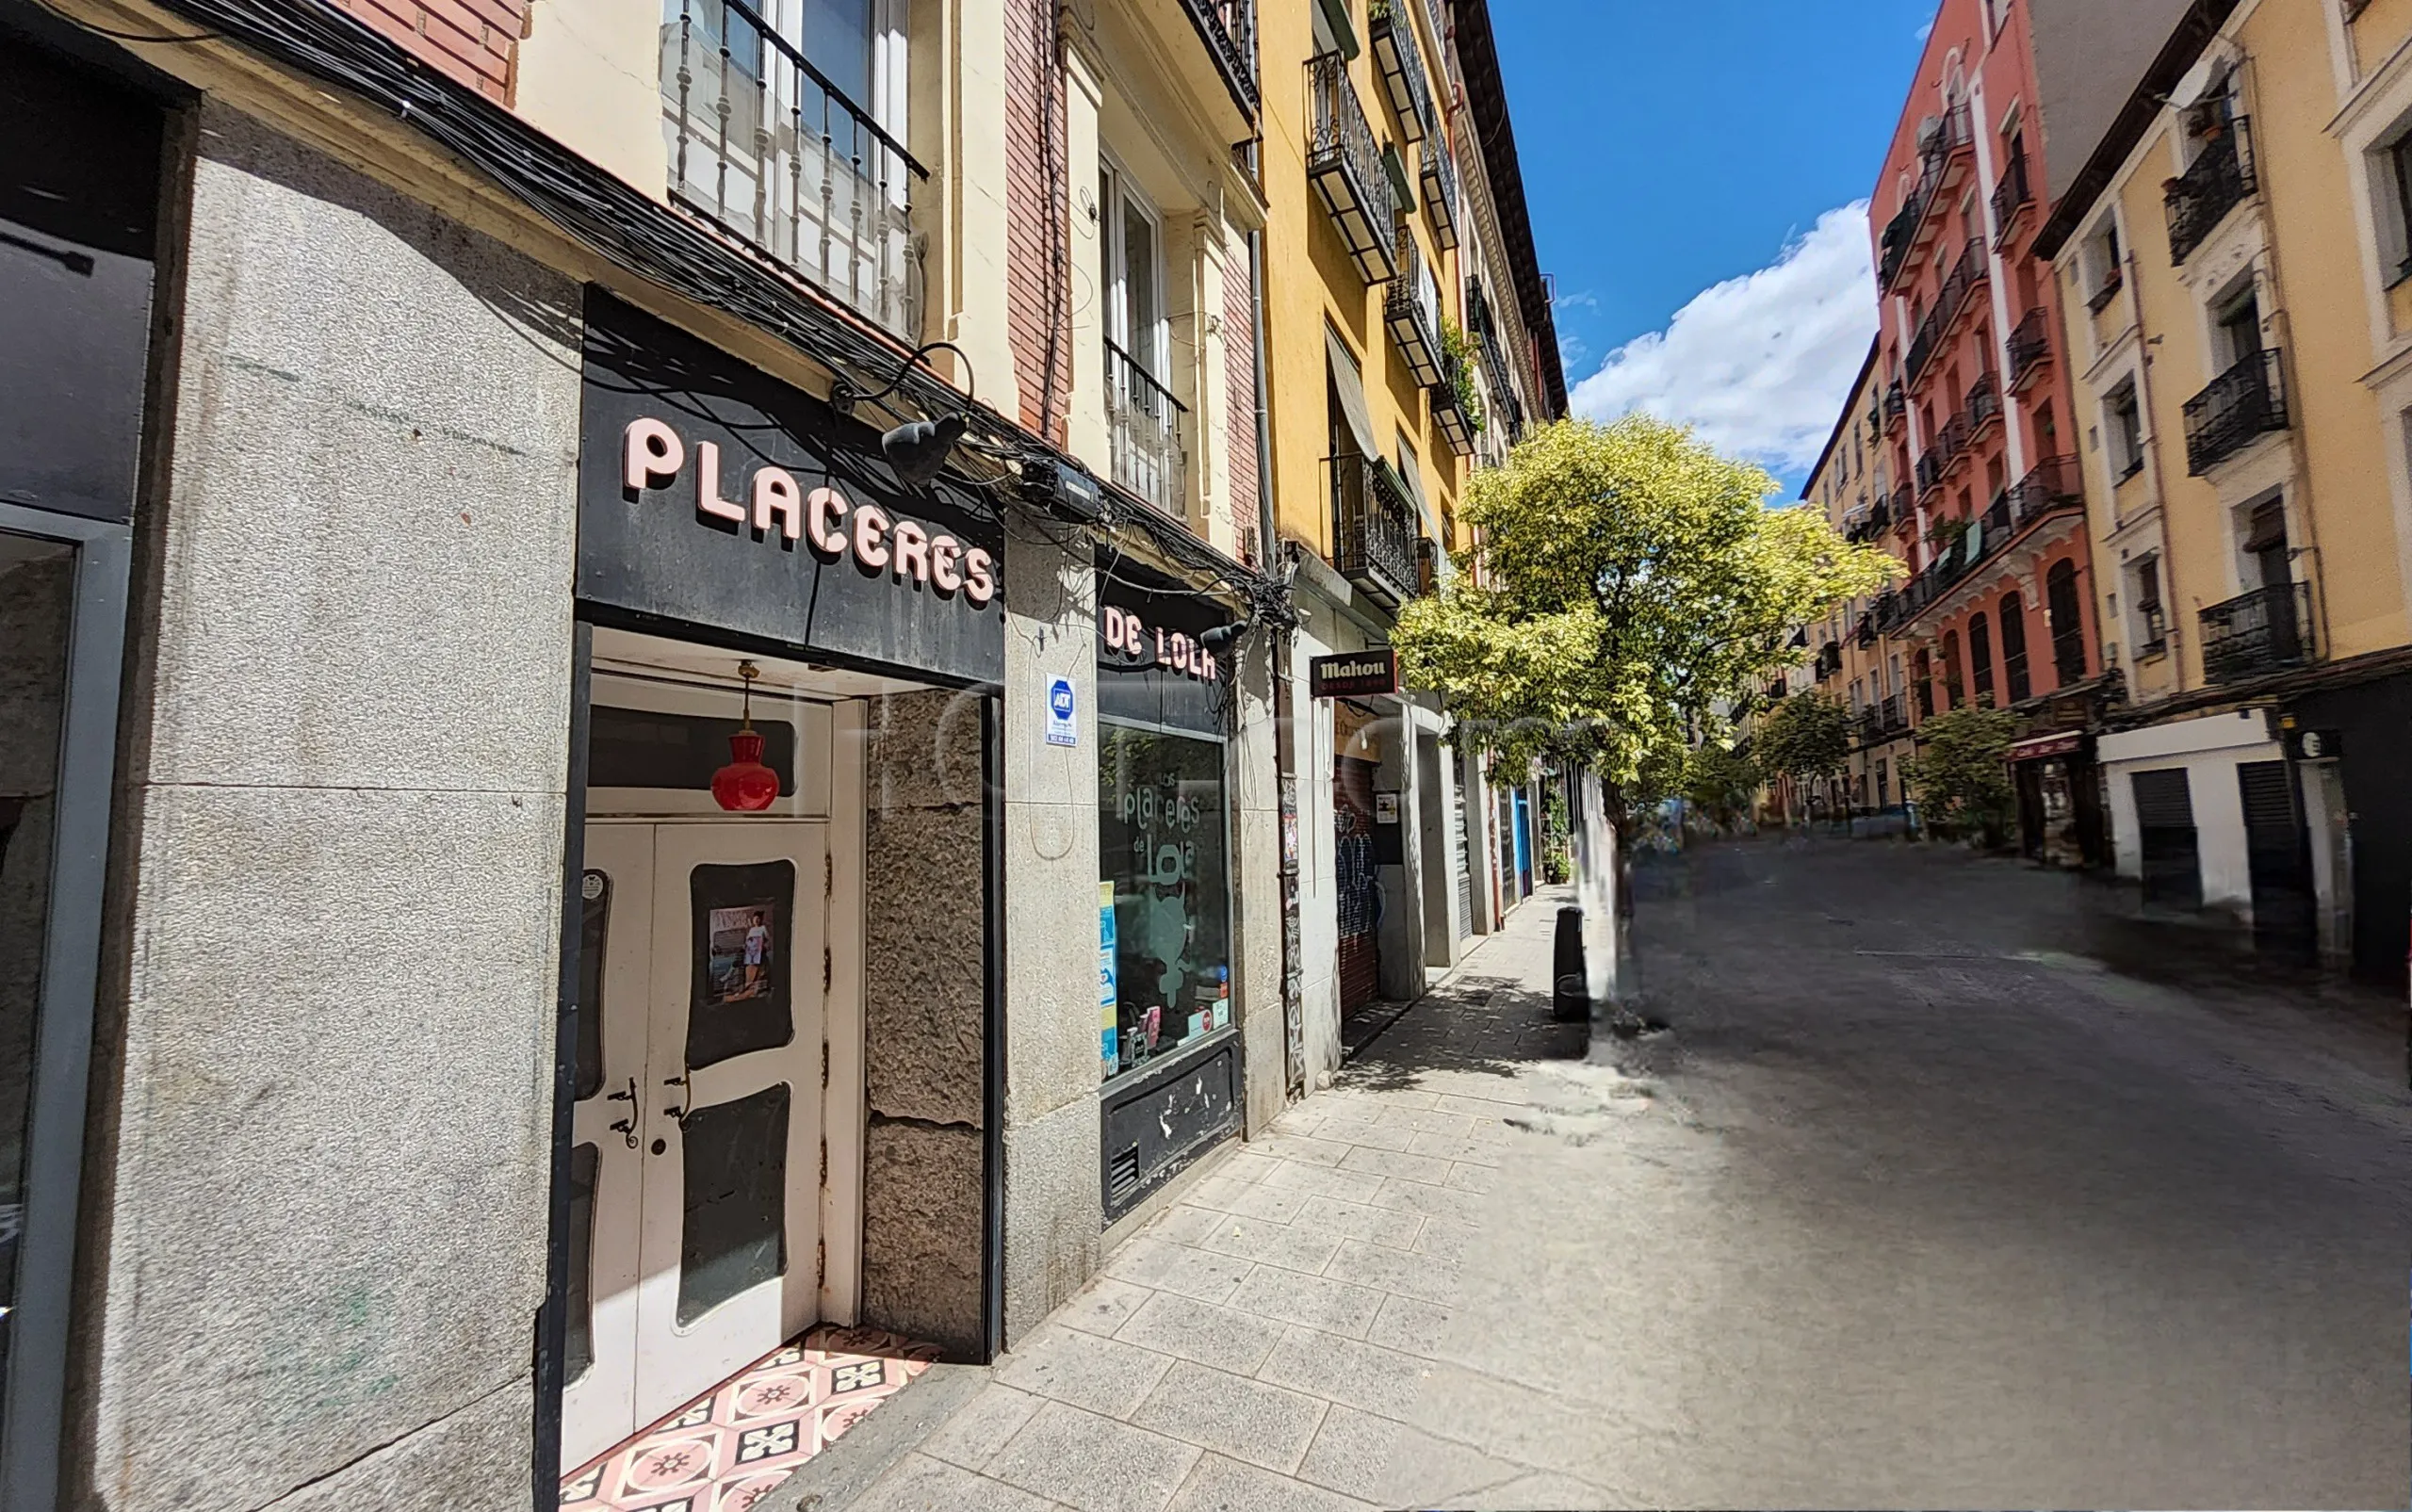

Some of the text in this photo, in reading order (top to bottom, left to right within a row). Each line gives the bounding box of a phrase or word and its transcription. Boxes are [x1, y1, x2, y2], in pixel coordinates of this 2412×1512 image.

[624, 416, 995, 602] PLACERES
[1103, 606, 1142, 656] DE
[1320, 659, 1386, 679] Mahou
[1053, 692, 1071, 708] ADT
[1133, 837, 1145, 853] de
